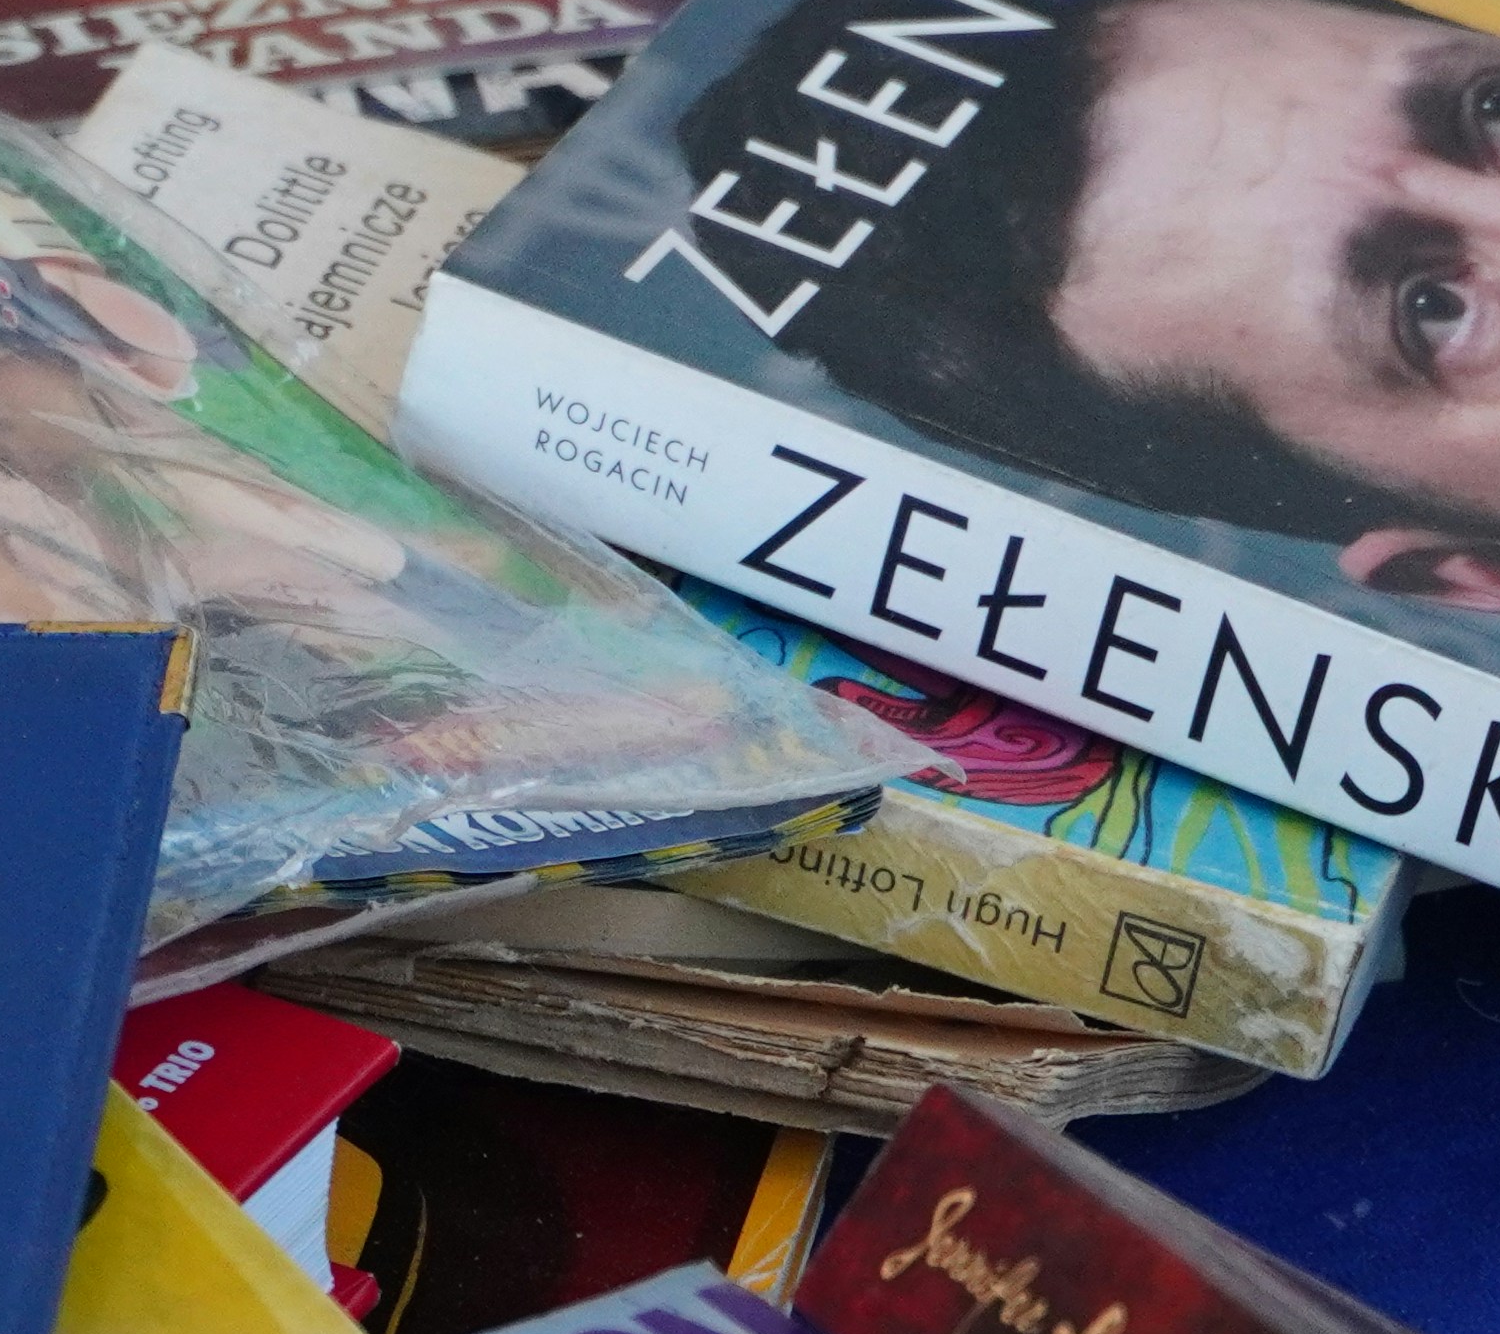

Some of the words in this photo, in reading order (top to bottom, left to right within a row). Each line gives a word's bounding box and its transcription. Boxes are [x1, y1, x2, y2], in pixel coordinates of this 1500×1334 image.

[224, 154, 348, 269] Dolittle
[302, 180, 428, 341] ajemnicze
[533, 384, 711, 474] WOJCIECH
[533, 428, 690, 508] ROGACIN
[947, 887, 1067, 954] Hugh
[139, 1038, 216, 1094] TRIO
